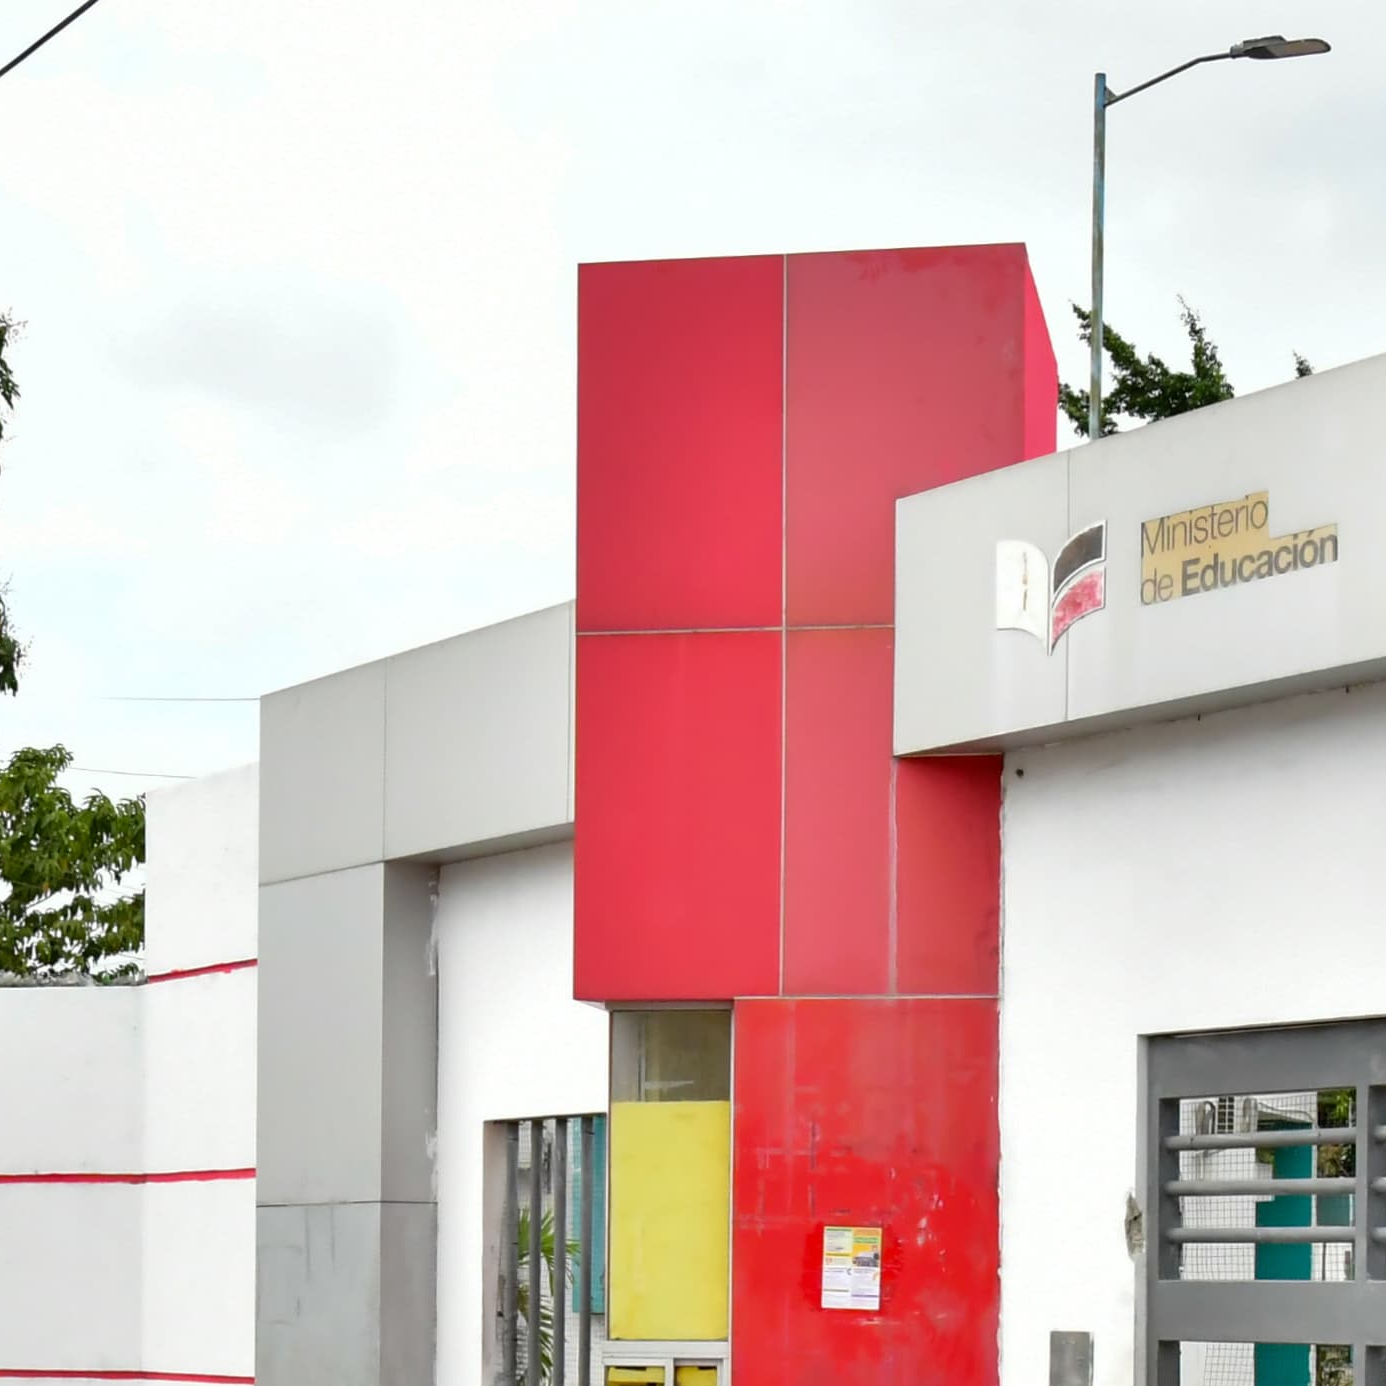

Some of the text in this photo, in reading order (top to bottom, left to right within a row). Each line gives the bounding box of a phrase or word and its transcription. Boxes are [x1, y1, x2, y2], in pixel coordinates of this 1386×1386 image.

[1140, 493, 1269, 557] Ministerio
[1140, 529, 1339, 606] de Educación
